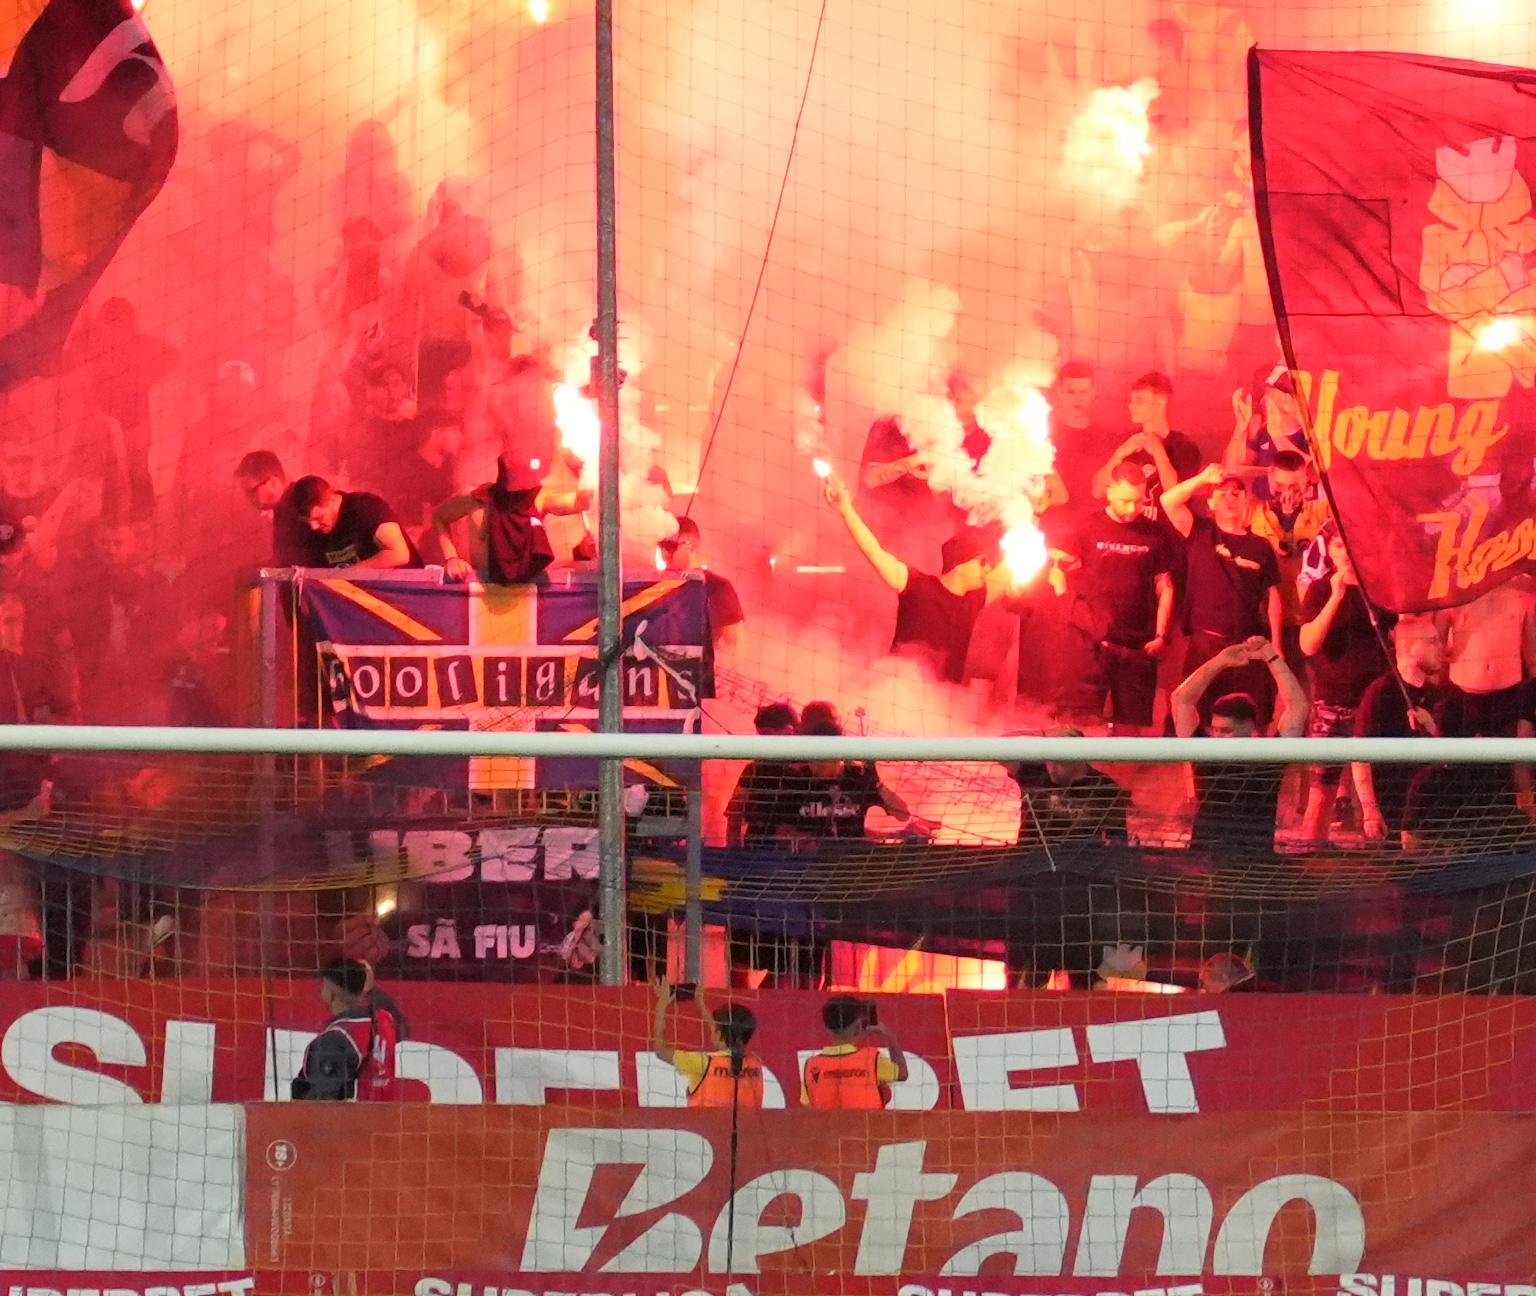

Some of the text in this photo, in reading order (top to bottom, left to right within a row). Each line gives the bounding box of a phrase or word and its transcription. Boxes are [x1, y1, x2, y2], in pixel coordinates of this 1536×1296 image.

[407, 917, 535, 959] SĂ FIU
[520, 1128, 1367, 1277] Betano
